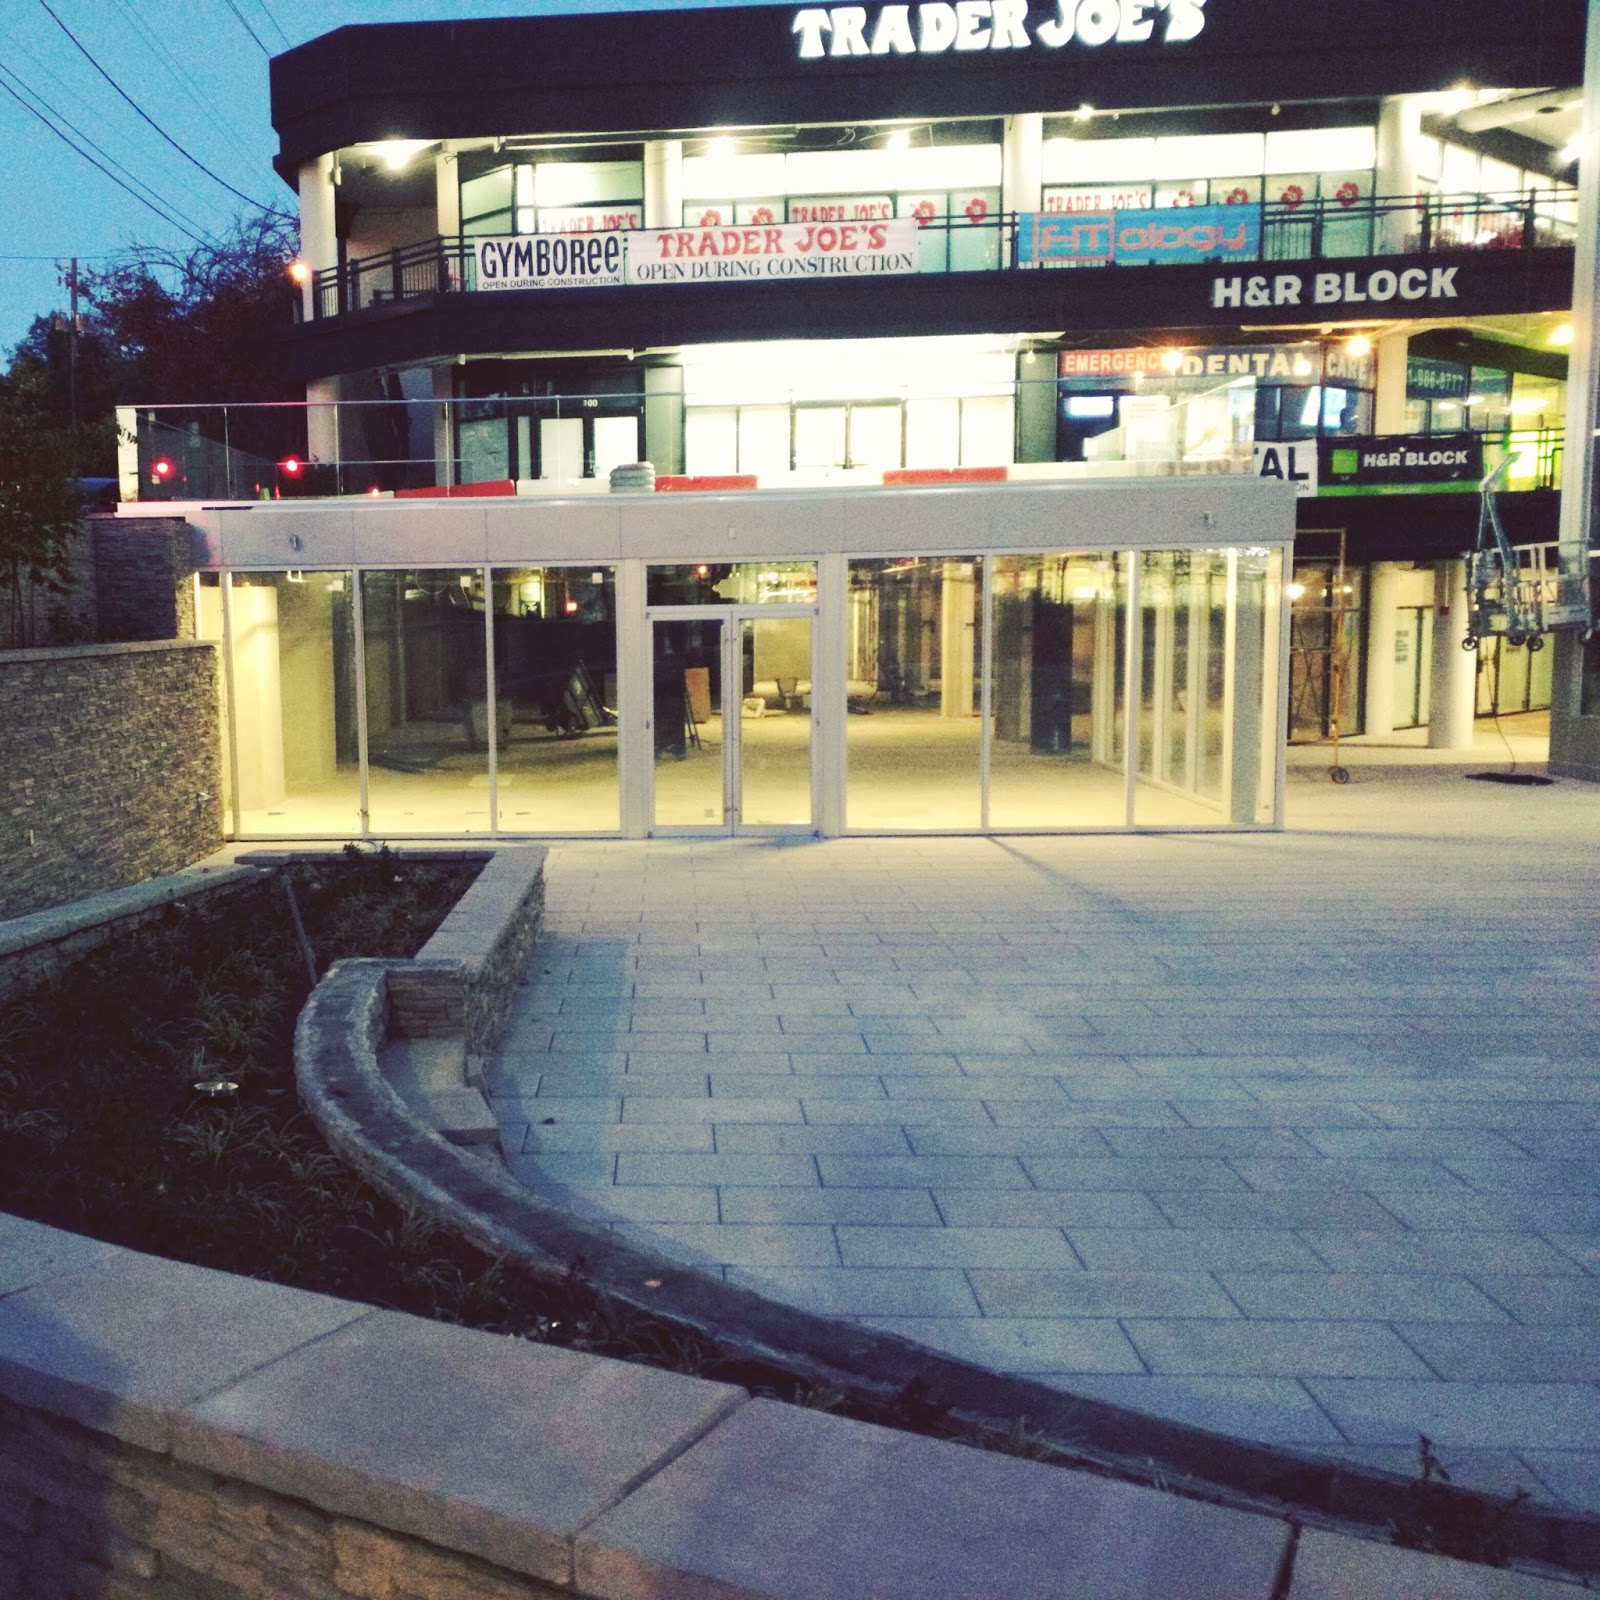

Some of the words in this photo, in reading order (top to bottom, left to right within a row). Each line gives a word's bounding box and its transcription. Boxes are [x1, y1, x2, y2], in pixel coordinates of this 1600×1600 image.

[792, 0, 1031, 58] TRADER
[1036, 0, 1206, 47] JOE'S
[792, 205, 846, 222] TRADER
[853, 201, 890, 221] JOE'S
[1047, 194, 1101, 213] TRADER
[1112, 190, 1147, 209] JOE'S
[656, 228, 784, 258] TRADER
[794, 223, 890, 252] JOE'S
[637, 262, 686, 281] OPEN
[692, 259, 762, 279] DURING
[767, 252, 915, 277] CONSTRUCTION
[482, 281, 508, 290] OPEN
[510, 278, 546, 288] DURING
[548, 276, 621, 287] CONSTRUCTION
[1213, 274, 1303, 308] H&R
[1313, 266, 1460, 304] BLOCK
[1065, 352, 1176, 373] EMERGENC
[1326, 352, 1372, 380] CARE
[1254, 446, 1310, 481] AL
[1363, 452, 1402, 467] H&R
[1404, 450, 1468, 467] BLOCK
